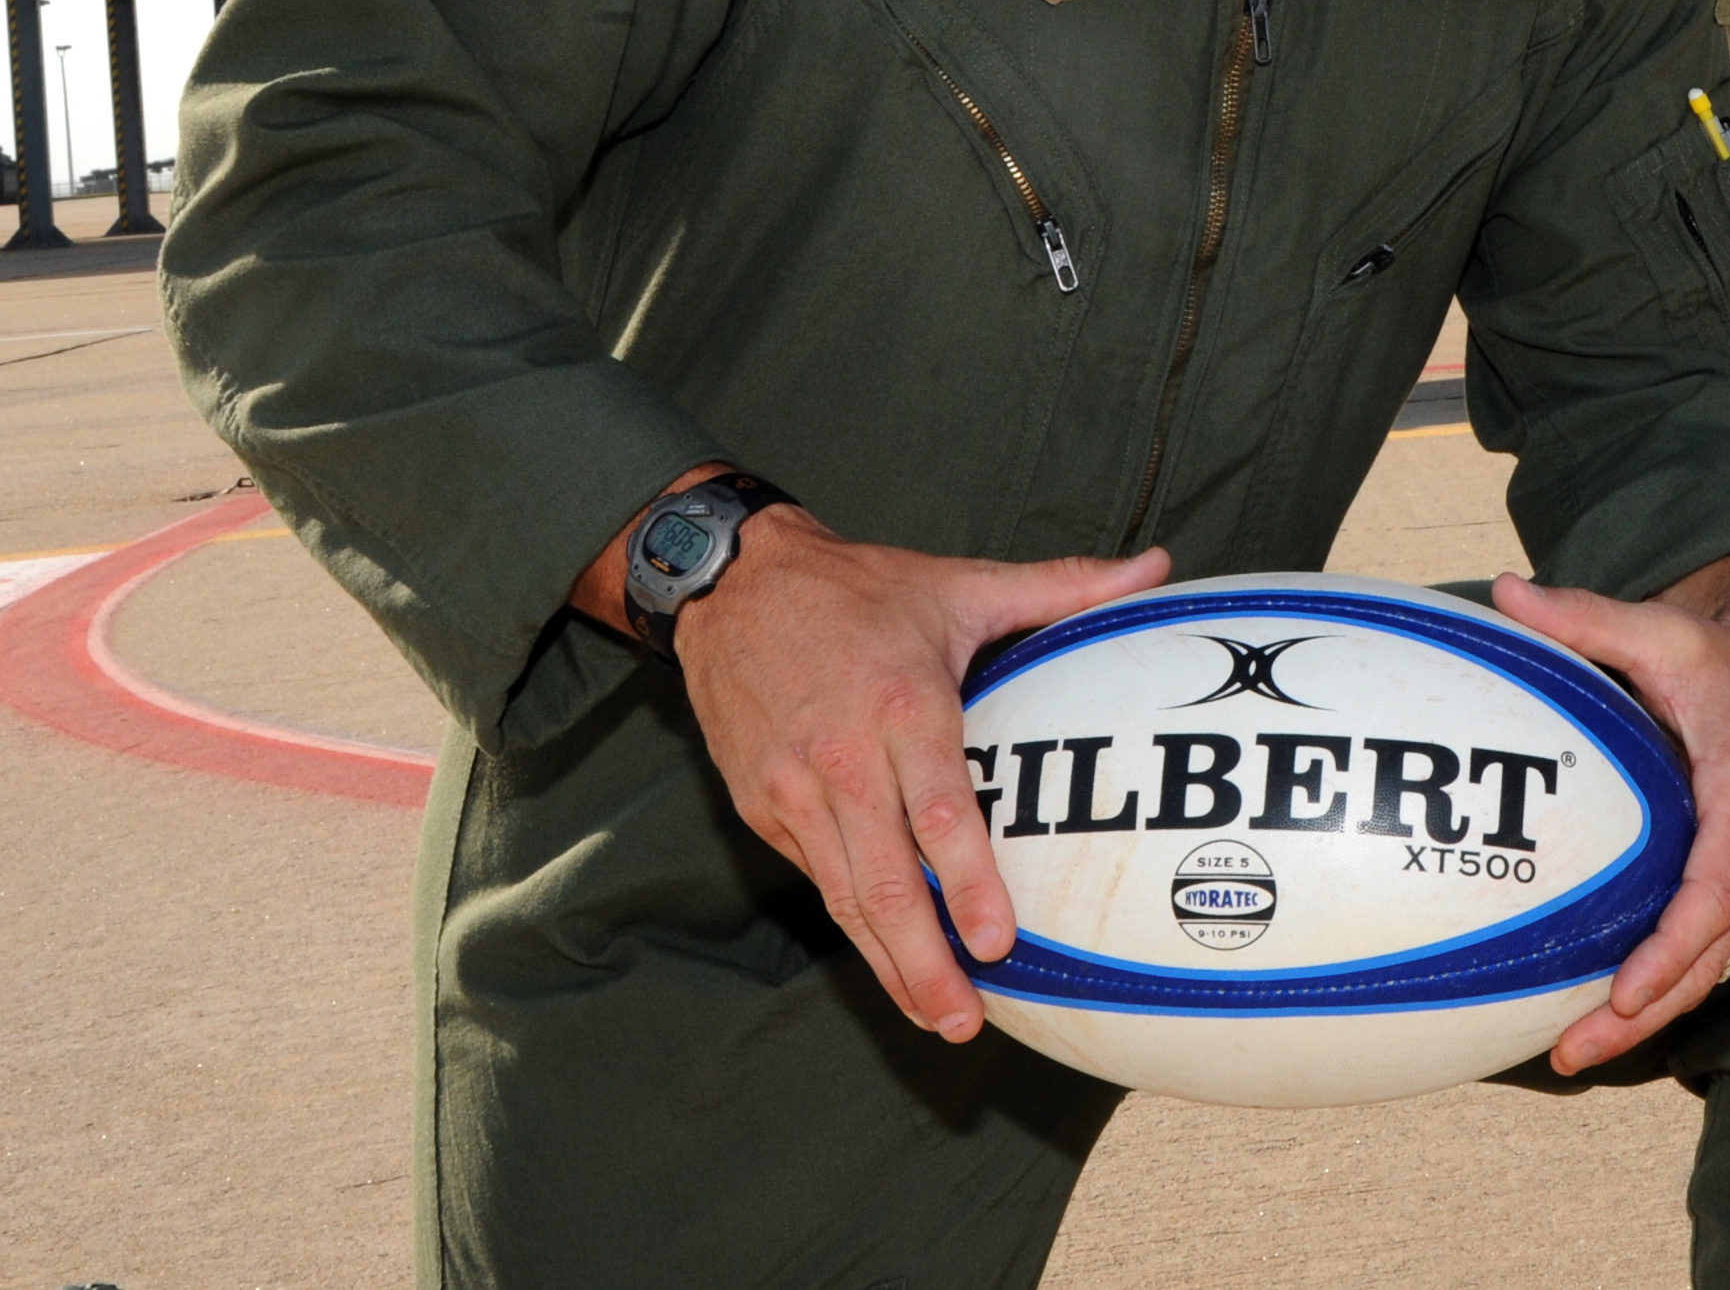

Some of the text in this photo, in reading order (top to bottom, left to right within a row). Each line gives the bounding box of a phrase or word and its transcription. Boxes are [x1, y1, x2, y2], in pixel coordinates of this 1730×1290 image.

[1196, 856, 1250, 868] SIZE 5
[1402, 844, 1536, 884] XT500
[1184, 889, 1259, 908] HYDRATEC
[1198, 929, 1251, 939] 9-10 PSI
